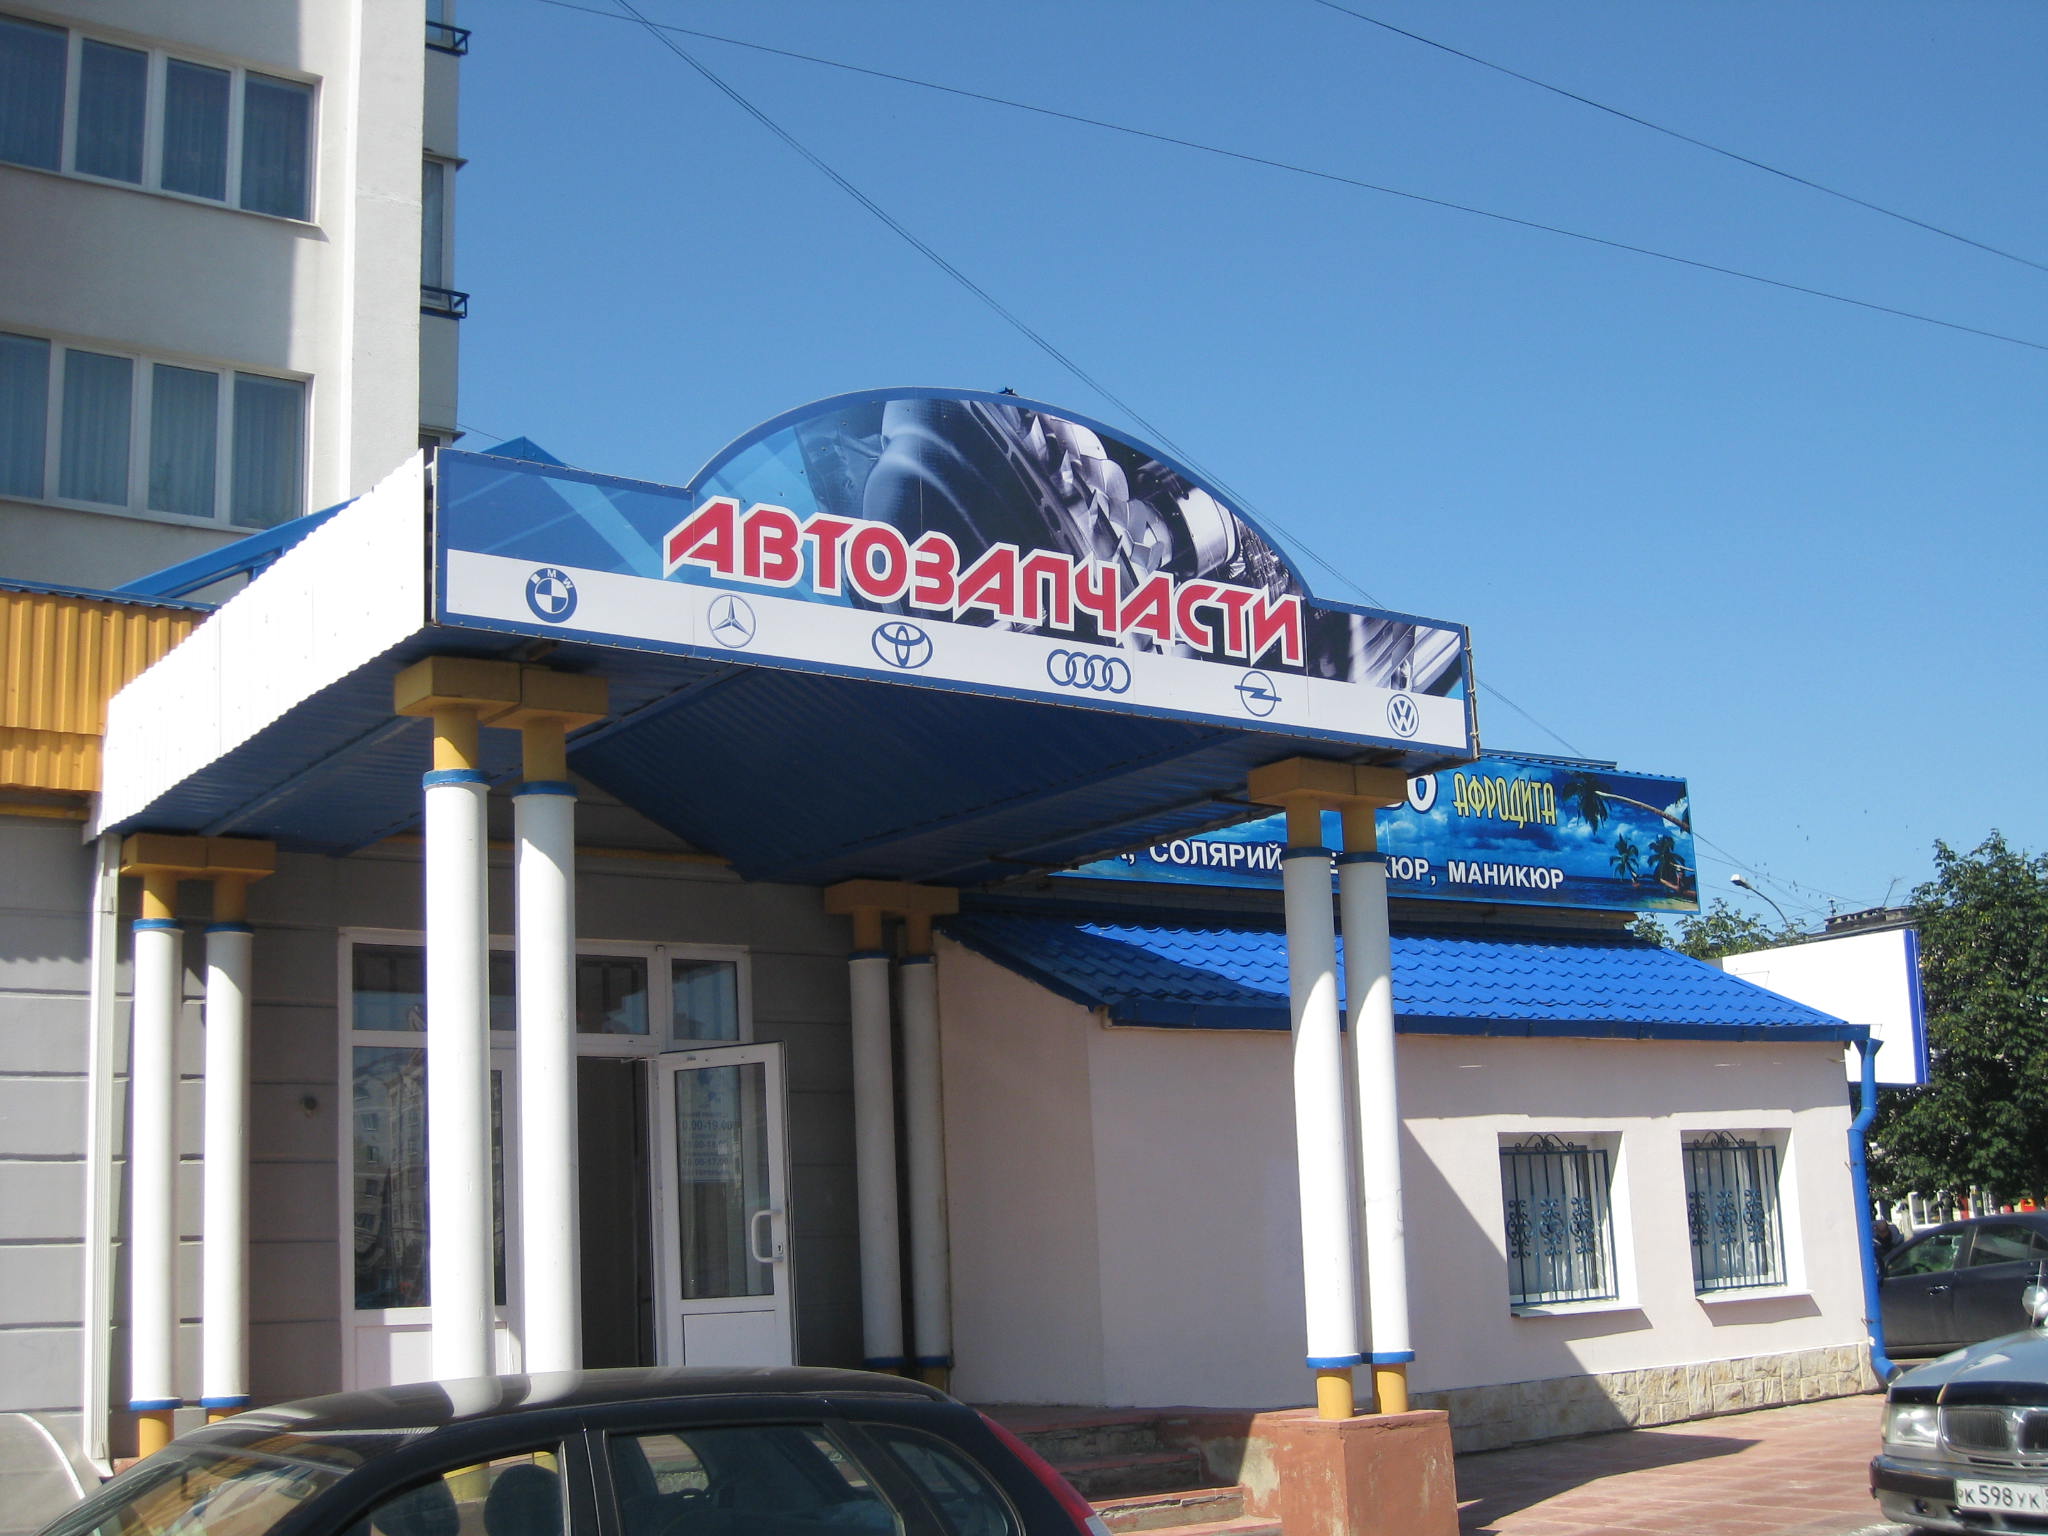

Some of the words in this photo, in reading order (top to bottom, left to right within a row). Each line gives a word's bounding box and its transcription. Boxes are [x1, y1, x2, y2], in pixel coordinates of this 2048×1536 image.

[530, 568, 573, 590] BMW
[663, 495, 1304, 668] АВТОЗАПЧАСТИ
[1453, 772, 1558, 829] АФРОДИТА
[1447, 860, 1564, 889] МАНИКЮР
